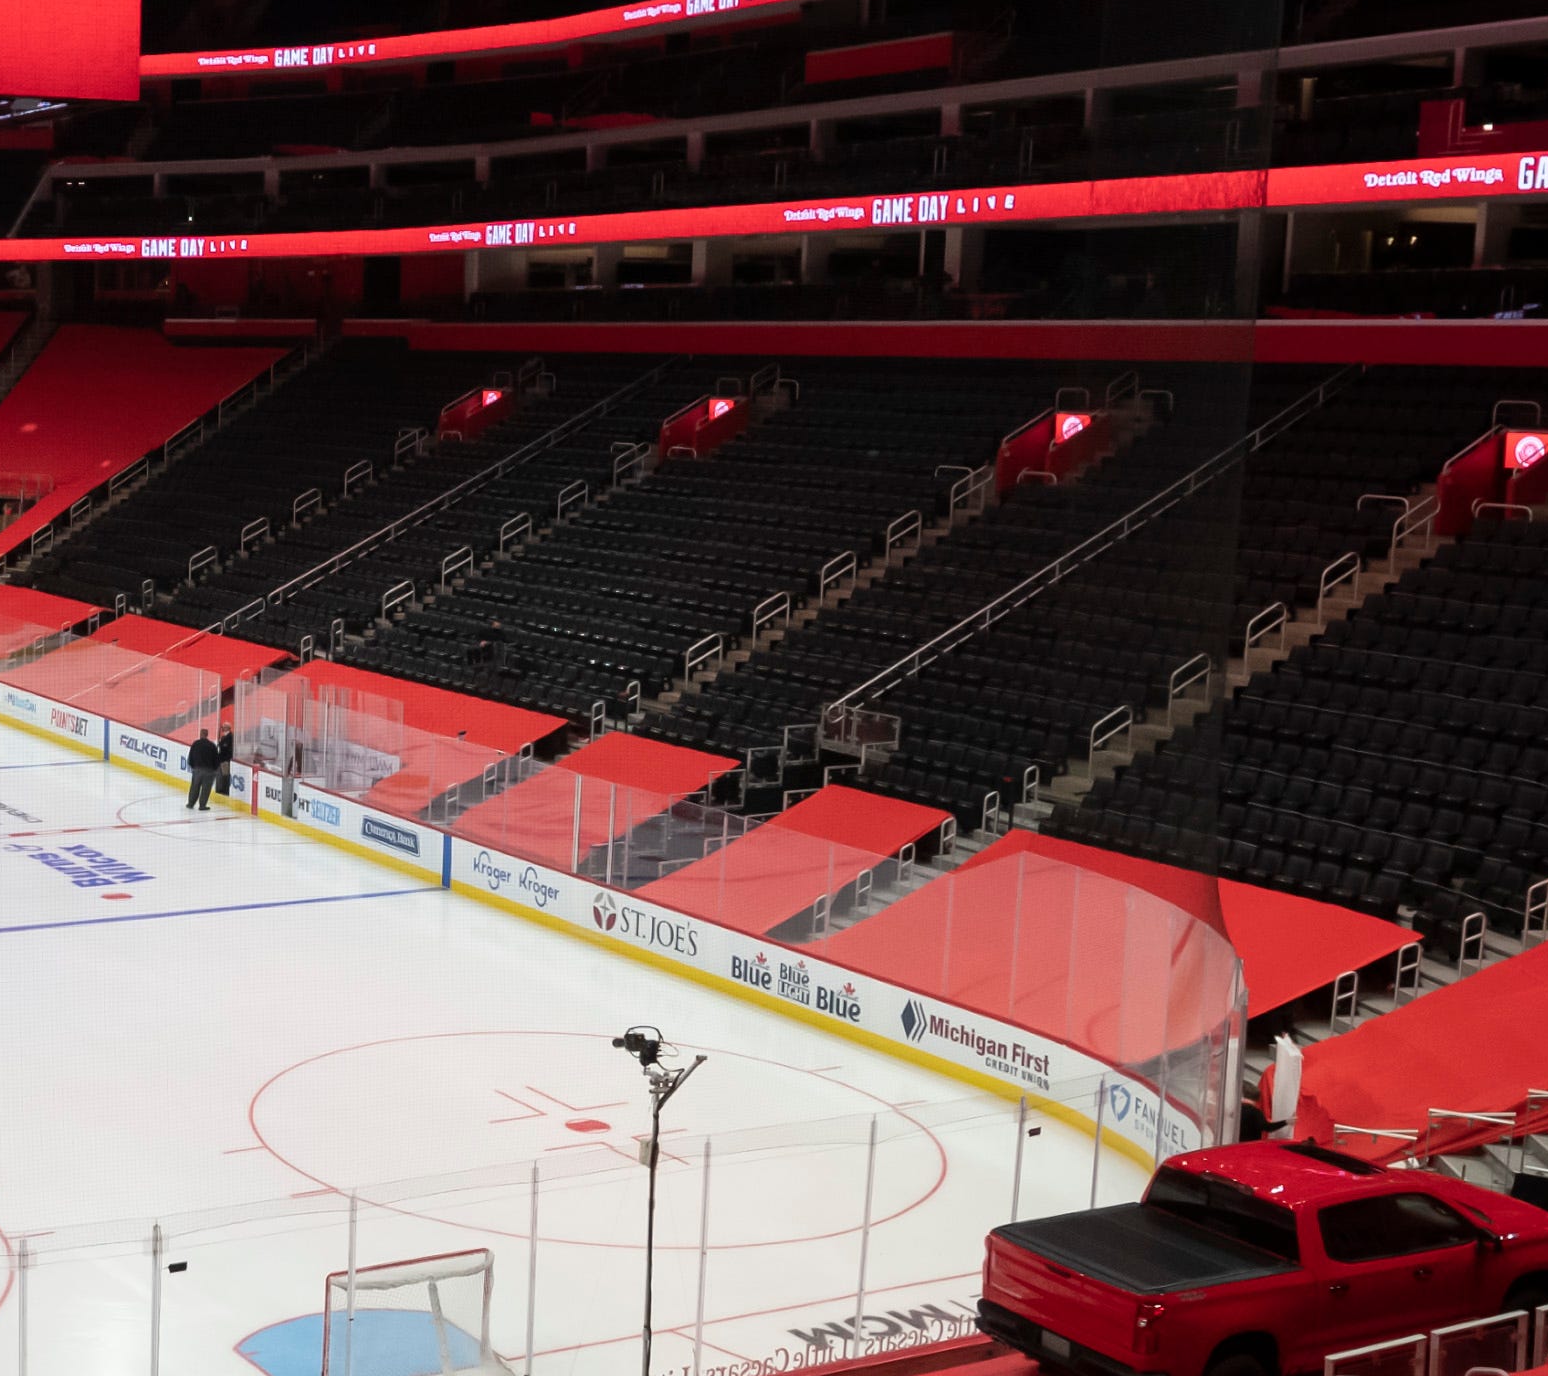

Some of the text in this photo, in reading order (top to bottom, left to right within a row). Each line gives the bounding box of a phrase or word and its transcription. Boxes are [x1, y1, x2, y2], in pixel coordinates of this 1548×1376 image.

[274, 44, 376, 67] GAME DAY LIVE
[1364, 171, 1418, 188] Detroit
[1419, 170, 1451, 188] Red
[1451, 167, 1504, 184] Wings
[872, 196, 914, 224] GAME
[918, 195, 949, 223] DAY
[956, 194, 1015, 214] LIVE
[141, 239, 248, 257] GAME DAY LIVE
[485, 224, 513, 245] GAME
[515, 222, 535, 244] DAY
[50, 708, 89, 737] POINTSBET
[119, 734, 168, 763] FALKEN
[26, 853, 118, 888] Burns
[57, 844, 157, 884] Wilcox
[473, 851, 511, 890] Kroger
[519, 866, 560, 907] Kroger
[620, 906, 698, 957] ST. JOE'S
[732, 955, 772, 991] Blue
[779, 962, 810, 988] Blue
[816, 986, 861, 1023] Blue
[929, 1015, 1049, 1076] Michigan First
[984, 1057, 1050, 1091] CREDIT UNION
[1134, 1097, 1188, 1150] FANUEL
